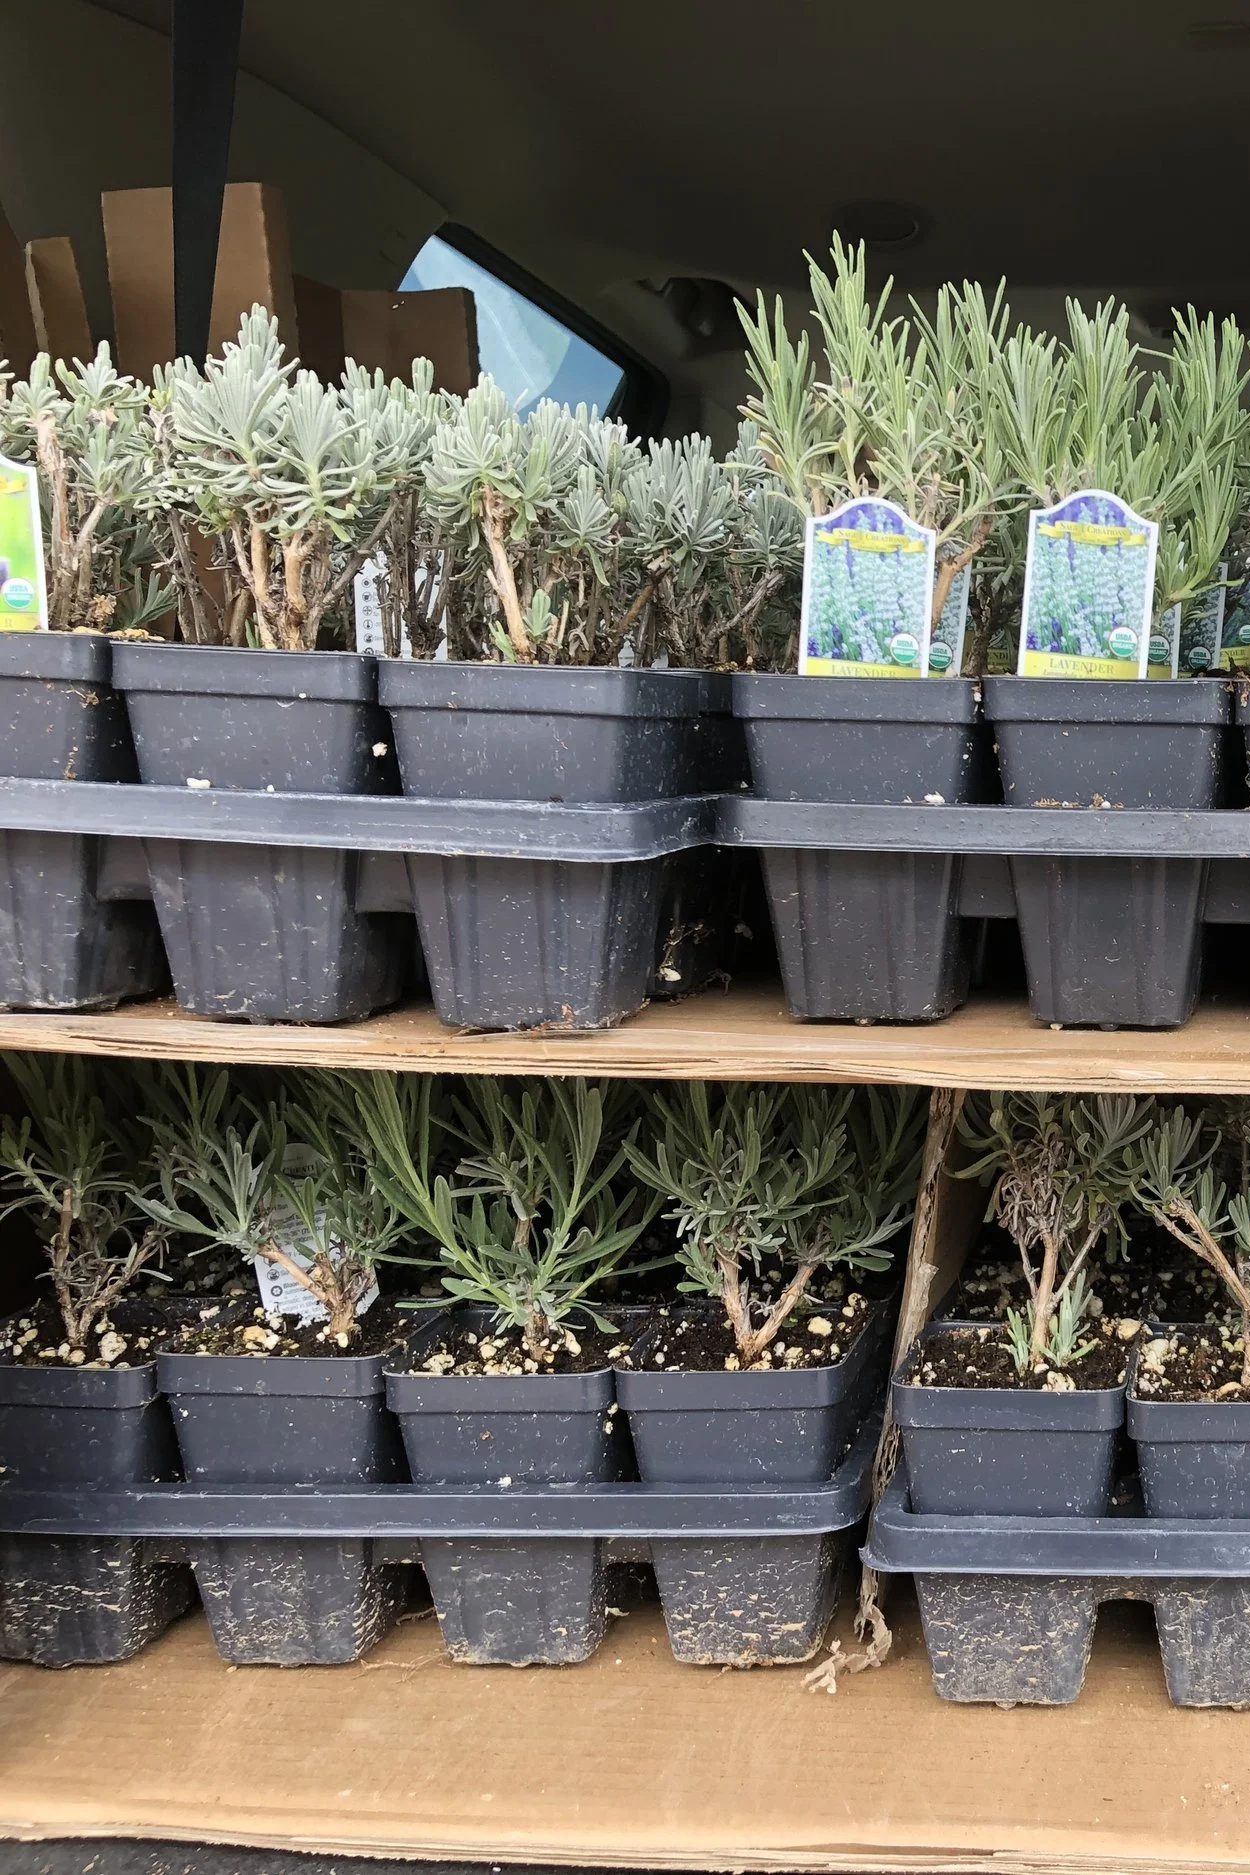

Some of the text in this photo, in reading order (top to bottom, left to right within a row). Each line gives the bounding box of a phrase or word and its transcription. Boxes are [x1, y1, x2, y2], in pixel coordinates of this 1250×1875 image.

[1086, 525, 1128, 537] CREATIONS
[1115, 632, 1132, 642] USDA
[897, 639, 913, 648] USDA
[1112, 641, 1135, 650] ORGANIC
[1150, 640, 1165, 648] USDA
[1149, 648, 1167, 656] ORGANIC
[832, 664, 896, 677] LAVENDER
[1050, 657, 1115, 675] LAVENDER
